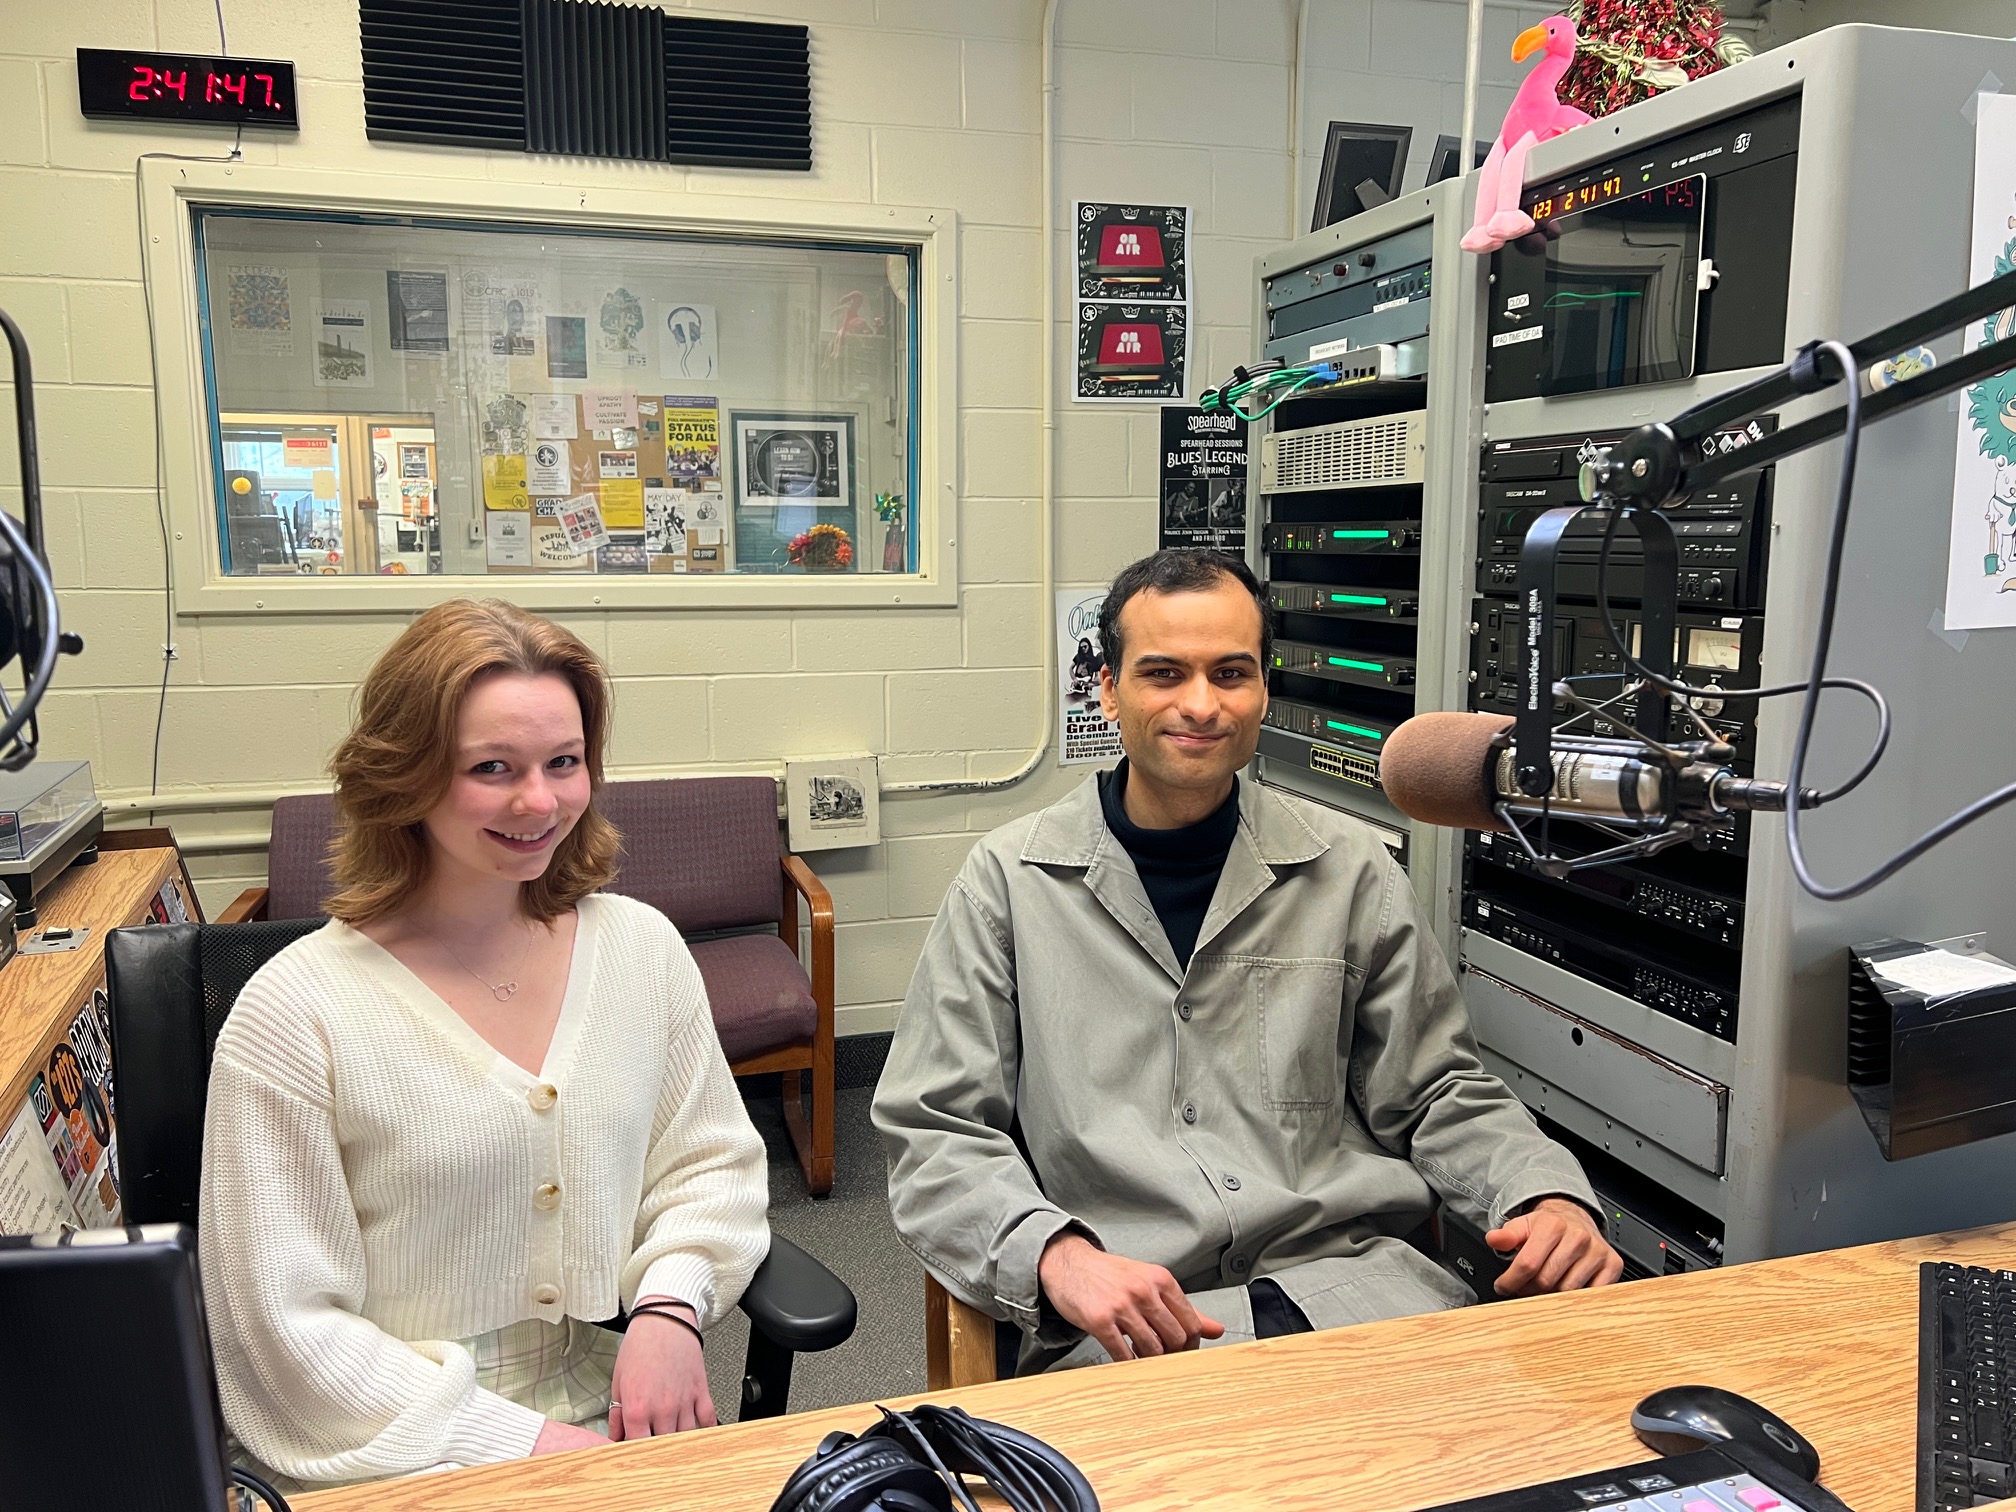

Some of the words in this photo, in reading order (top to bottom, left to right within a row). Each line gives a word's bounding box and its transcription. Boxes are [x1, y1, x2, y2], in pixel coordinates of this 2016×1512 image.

[1565, 192, 1574, 210] 2
[1580, 185, 1597, 204] 41
[1603, 176, 1621, 197] 47
[1120, 233, 1138, 244] ON
[1115, 244, 1141, 255] AIR
[1120, 332, 1138, 342] ON
[1116, 342, 1142, 353] AIR
[668, 423, 716, 432] STATUS
[669, 432, 693, 441] FOR
[695, 432, 716, 441] ALL
[1180, 439, 1214, 447] SPEARHEAD
[1215, 439, 1243, 447] SESSIONS
[1167, 451, 1202, 468] BLUES
[1192, 465, 1230, 476] STARRING
[665, 494, 682, 502] DAY
[537, 507, 556, 515] CHA
[540, 533, 566, 542] REFUG
[1527, 617, 1537, 646] Model
[1067, 715, 1102, 723] Live
[1066, 721, 1108, 733] Grad
[1066, 731, 1119, 740] December
[1080, 739, 1099, 747] Special
[1066, 751, 1106, 759] Doors
[1457, 1256, 1474, 1276] APC
